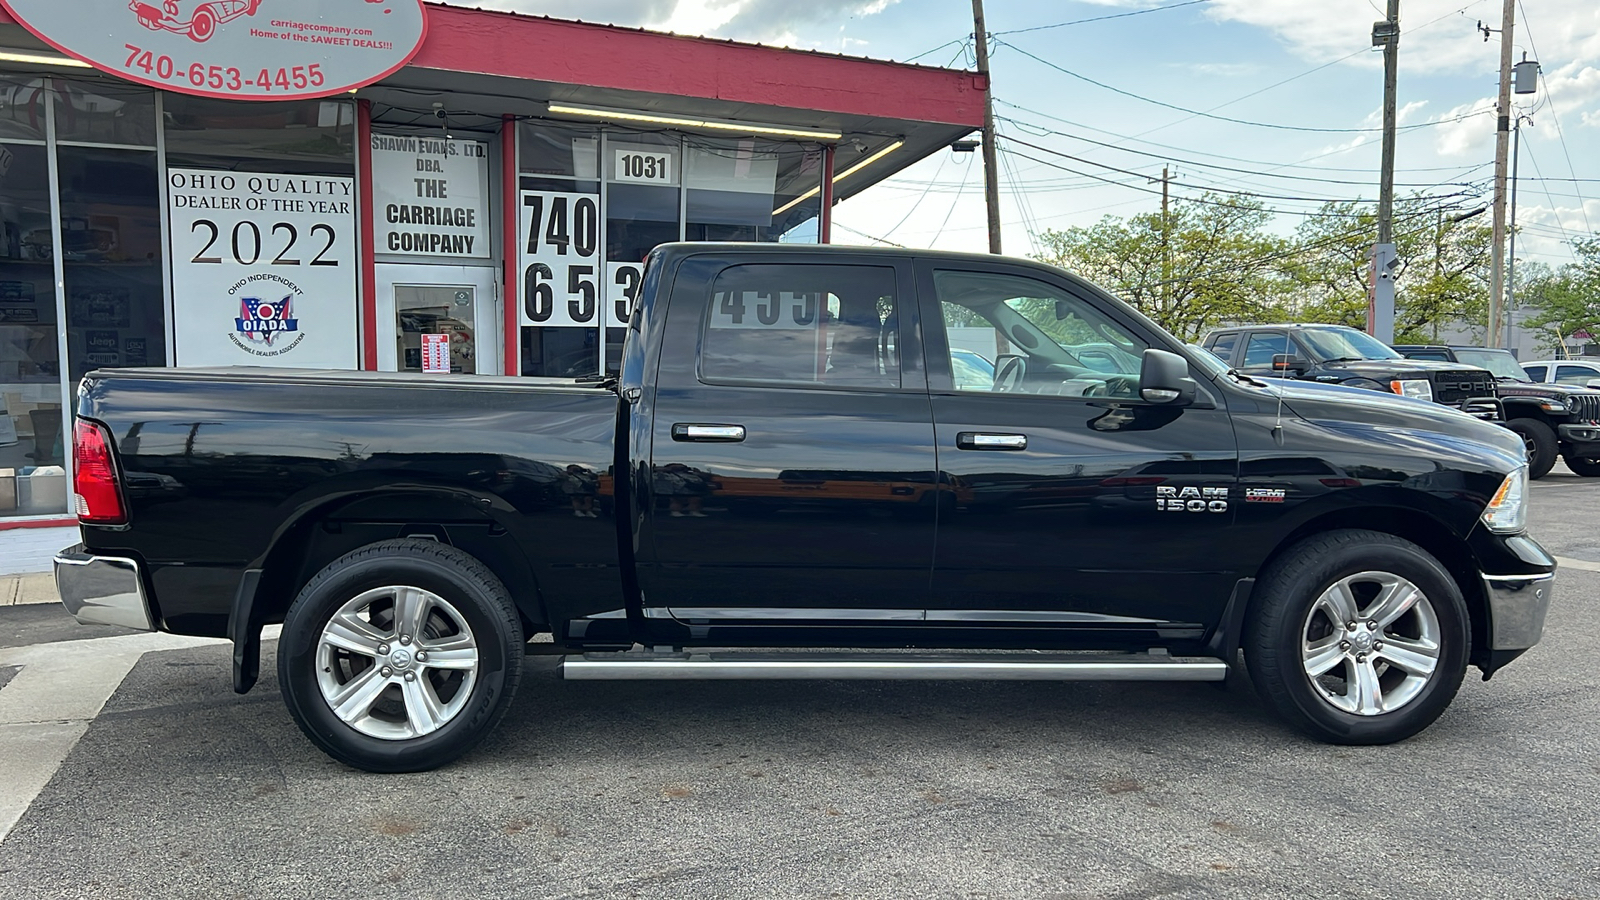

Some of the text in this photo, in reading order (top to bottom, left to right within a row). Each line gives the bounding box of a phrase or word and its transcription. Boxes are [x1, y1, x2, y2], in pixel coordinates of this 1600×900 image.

[270, 19, 372, 36] carriagecompany.com
[250, 28, 393, 50] Home of the SAWEET DEALS!!!
[124, 43, 324, 91] 740-653-4455
[371, 136, 486, 158] SHAWN EVANS. LTD.
[416, 158, 444, 173] DBA.
[621, 154, 666, 179] 1031
[171, 173, 352, 196] OHIO QUALITY
[414, 178, 447, 198] THE
[174, 195, 350, 214] DEALER OF THE YEAR
[386, 203, 475, 228] CARRIAGE
[524, 195, 596, 257] 740
[191, 219, 338, 266] 2022
[387, 231, 475, 254] COMPANY
[228, 273, 304, 296] OHIO INDEPENDENT
[243, 320, 287, 331] OIADA
[89, 337, 115, 347] Jeep
[228, 332, 255, 355] AUTOMOBILE
[280, 332, 305, 355] ASSOCIATION
[1156, 486, 1229, 499] RAM
[1246, 488, 1285, 496] HEMI
[1156, 499, 1228, 512] 1500
